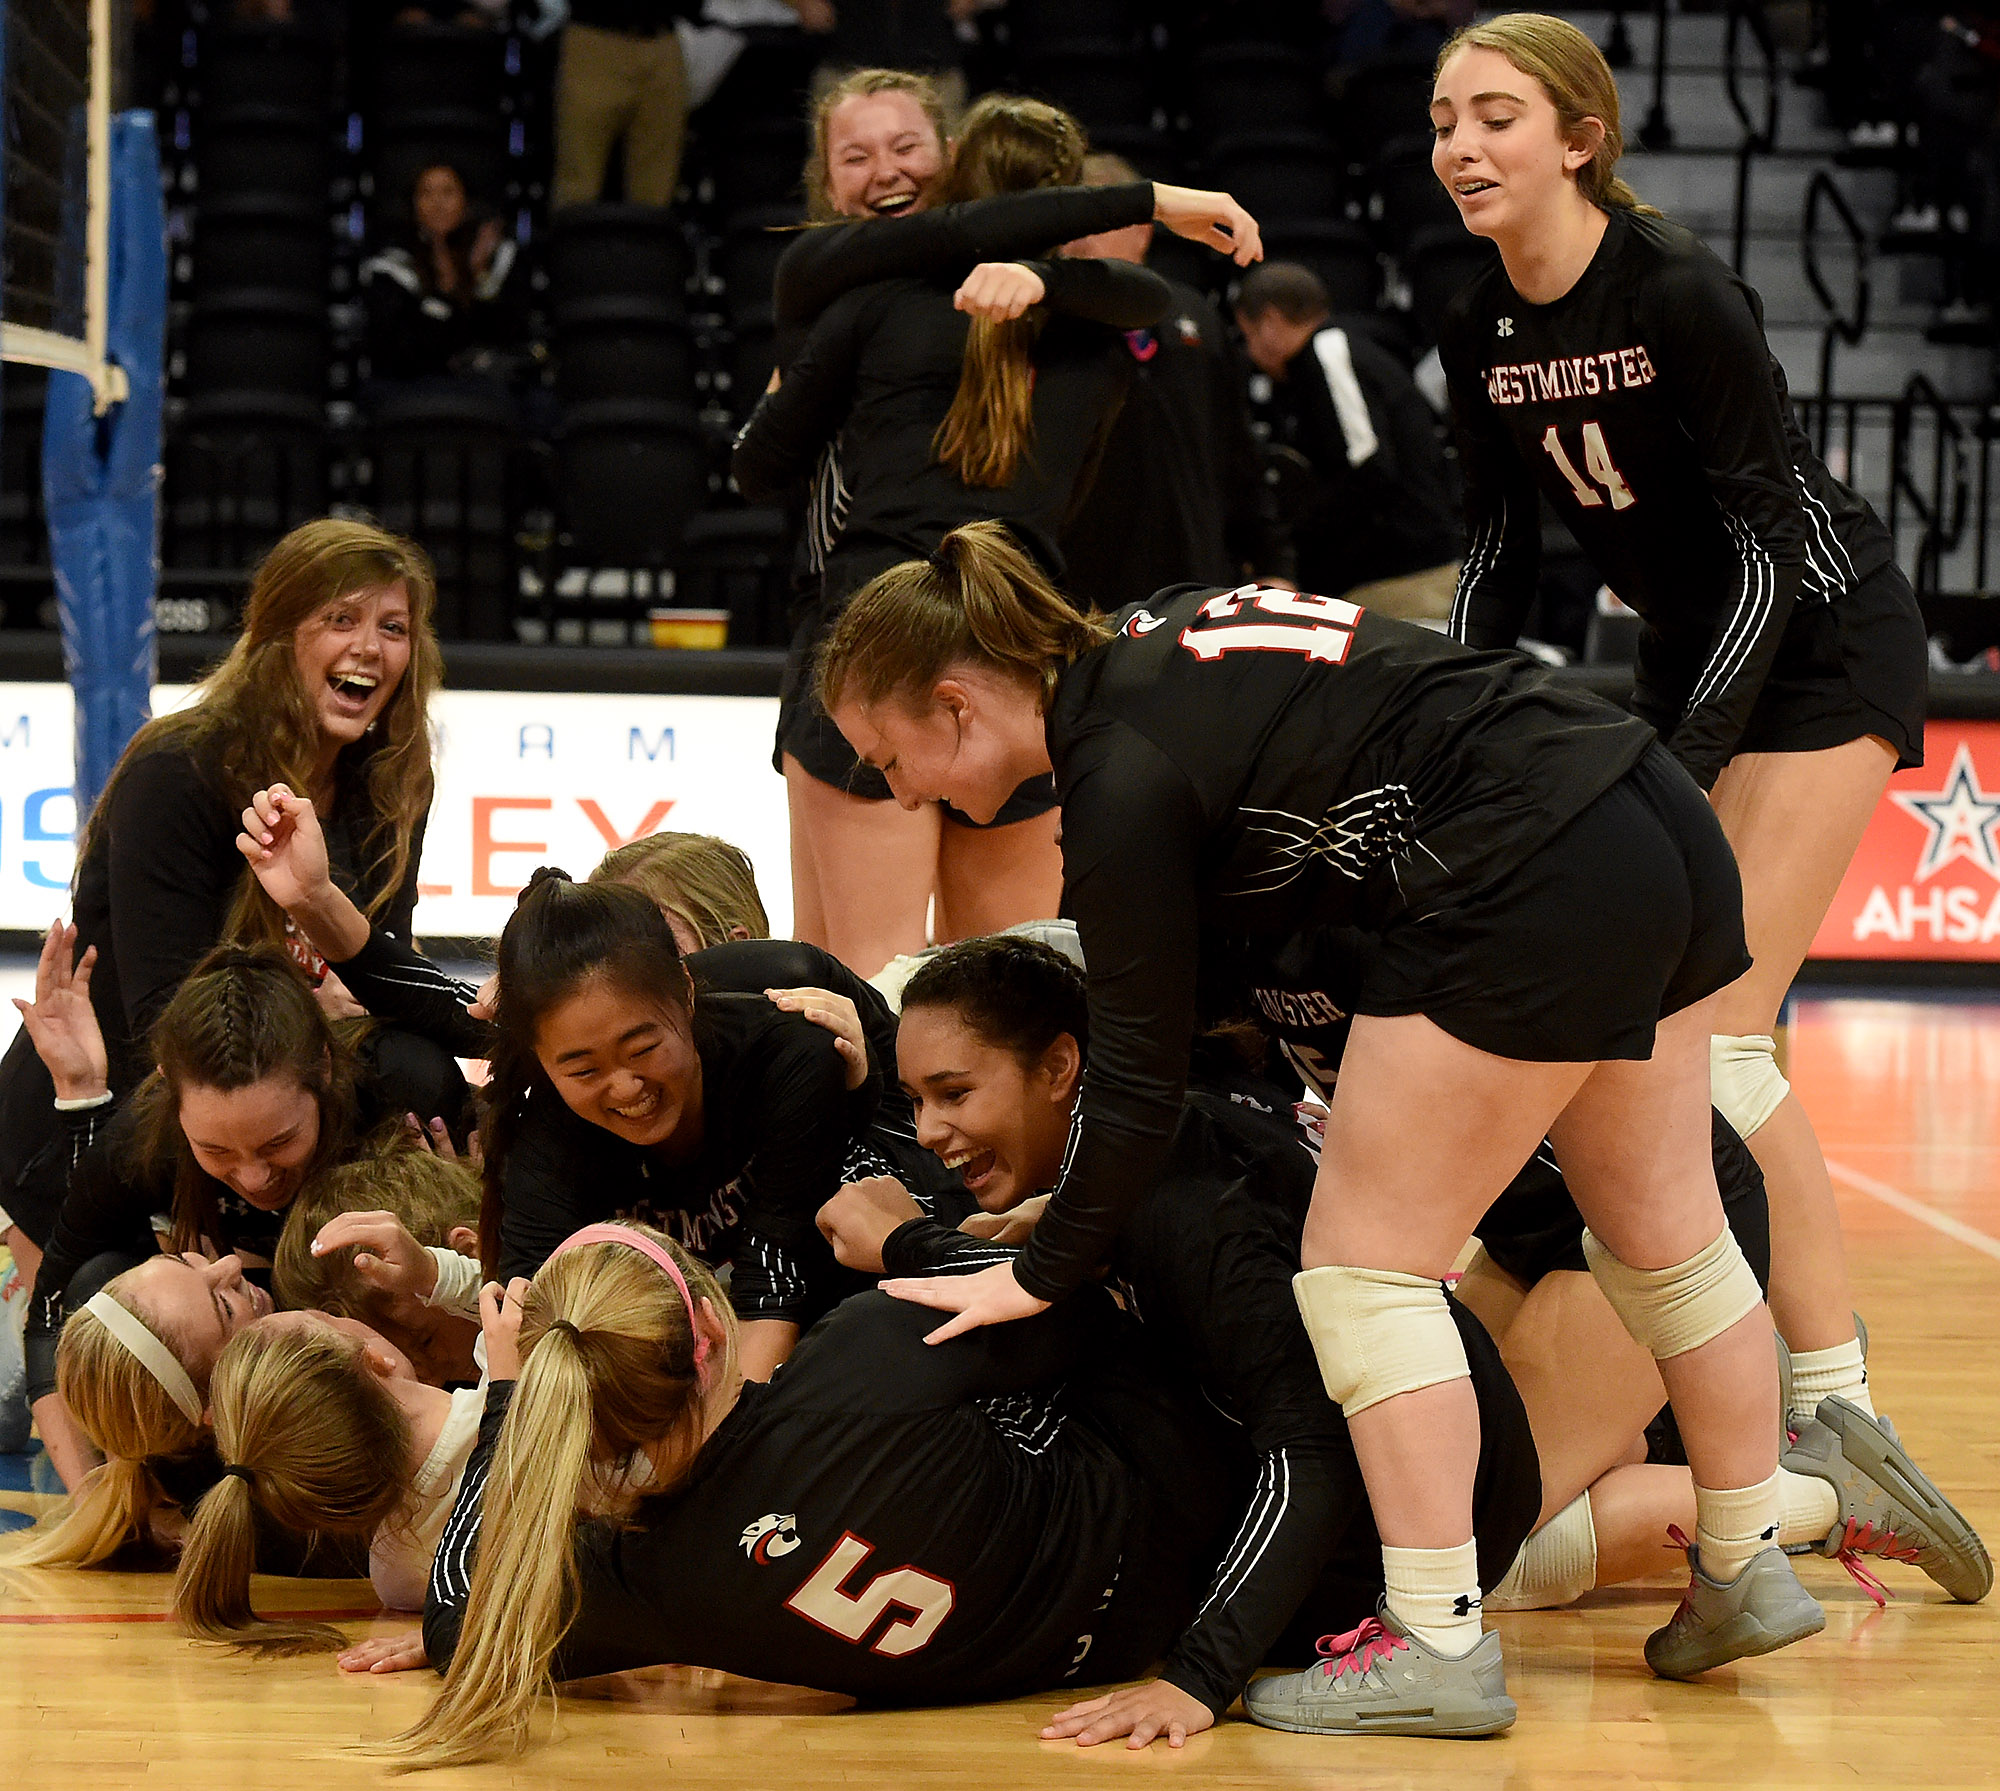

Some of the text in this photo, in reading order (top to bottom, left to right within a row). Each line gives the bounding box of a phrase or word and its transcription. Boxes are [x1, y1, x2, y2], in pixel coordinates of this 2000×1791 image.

[1481, 345, 1657, 405] WESTMINSTER
[1541, 419, 1638, 511] 14
[1178, 582, 1366, 666] 12
[783, 1529, 956, 1659] 5
